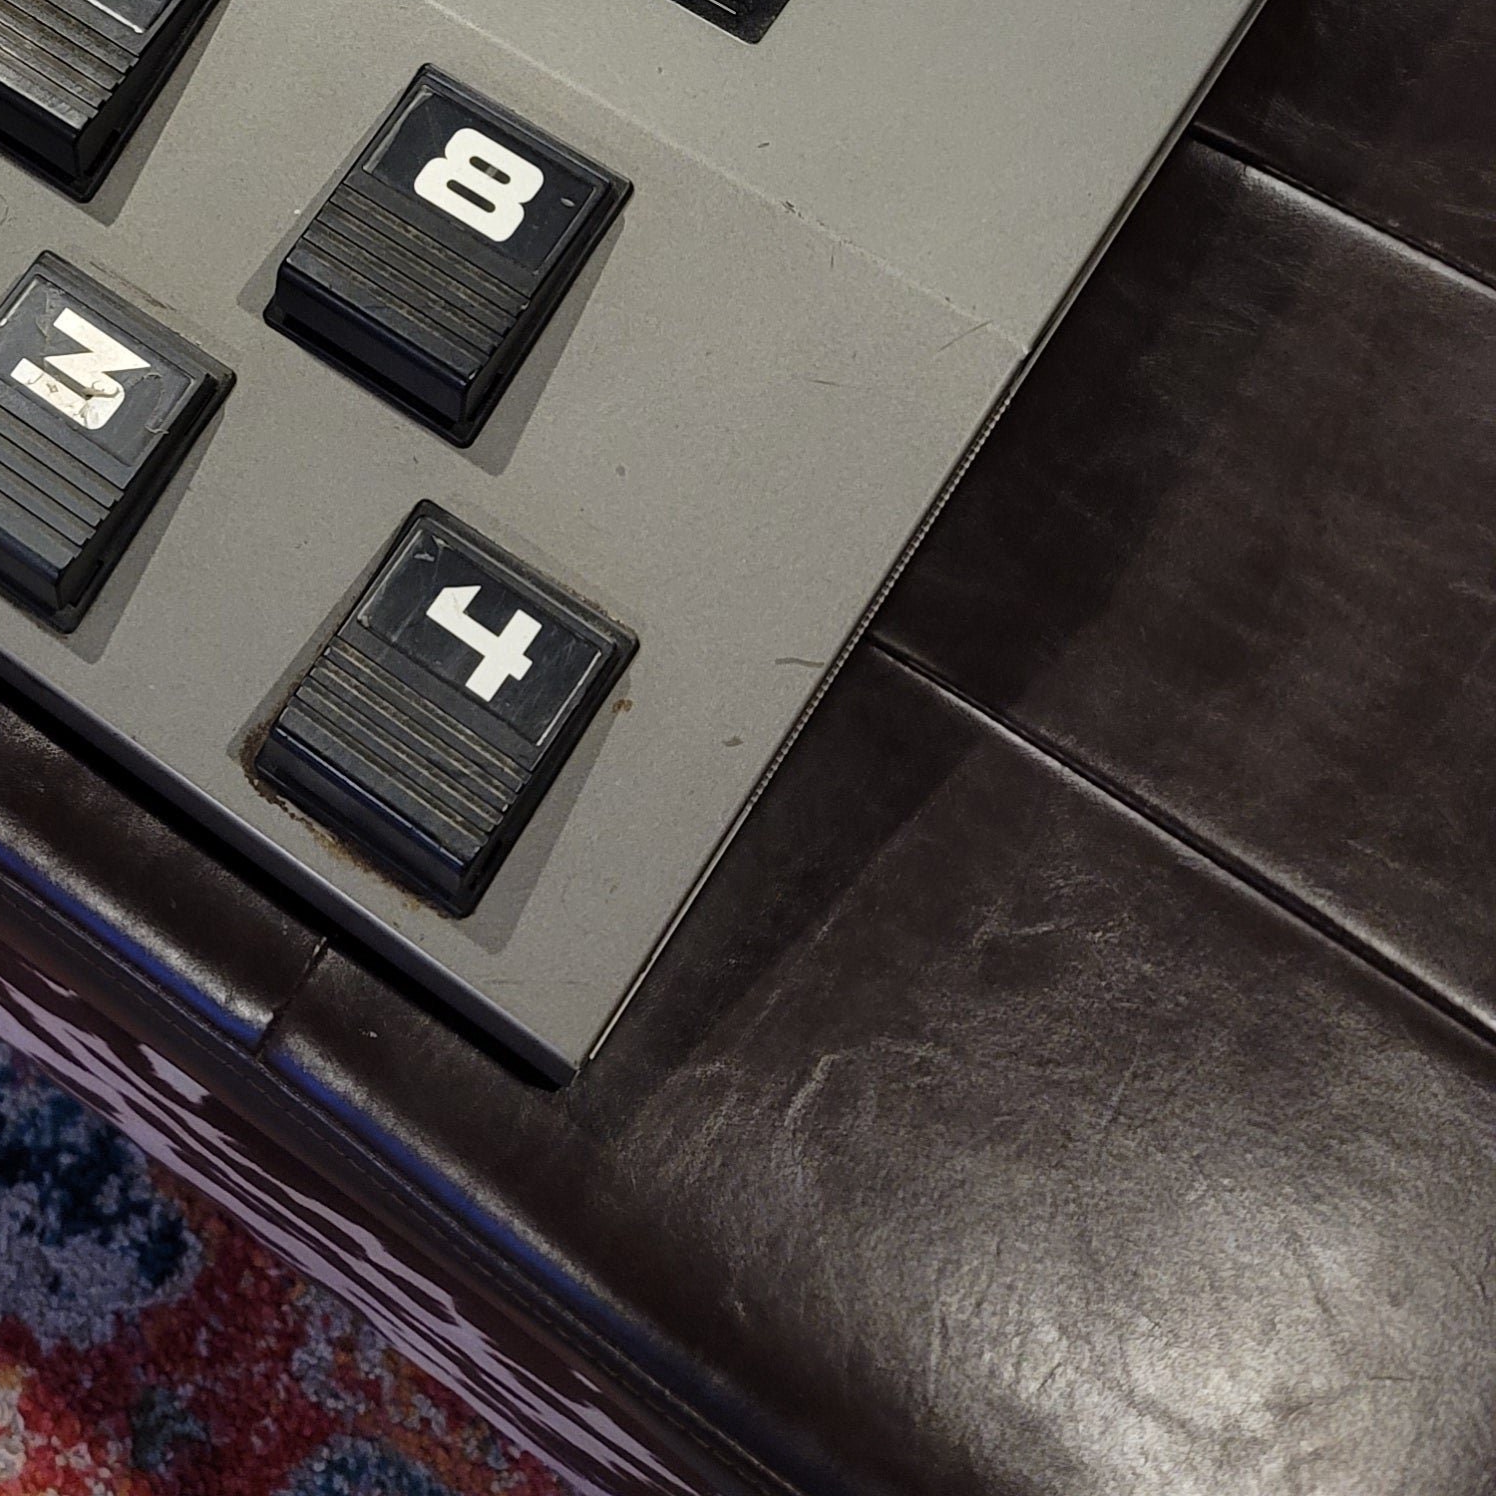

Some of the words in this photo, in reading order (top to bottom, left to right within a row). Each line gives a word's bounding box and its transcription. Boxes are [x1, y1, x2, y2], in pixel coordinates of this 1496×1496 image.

[413, 128, 545, 243] 8
[10, 307, 153, 430] 3
[425, 585, 543, 703] 4
